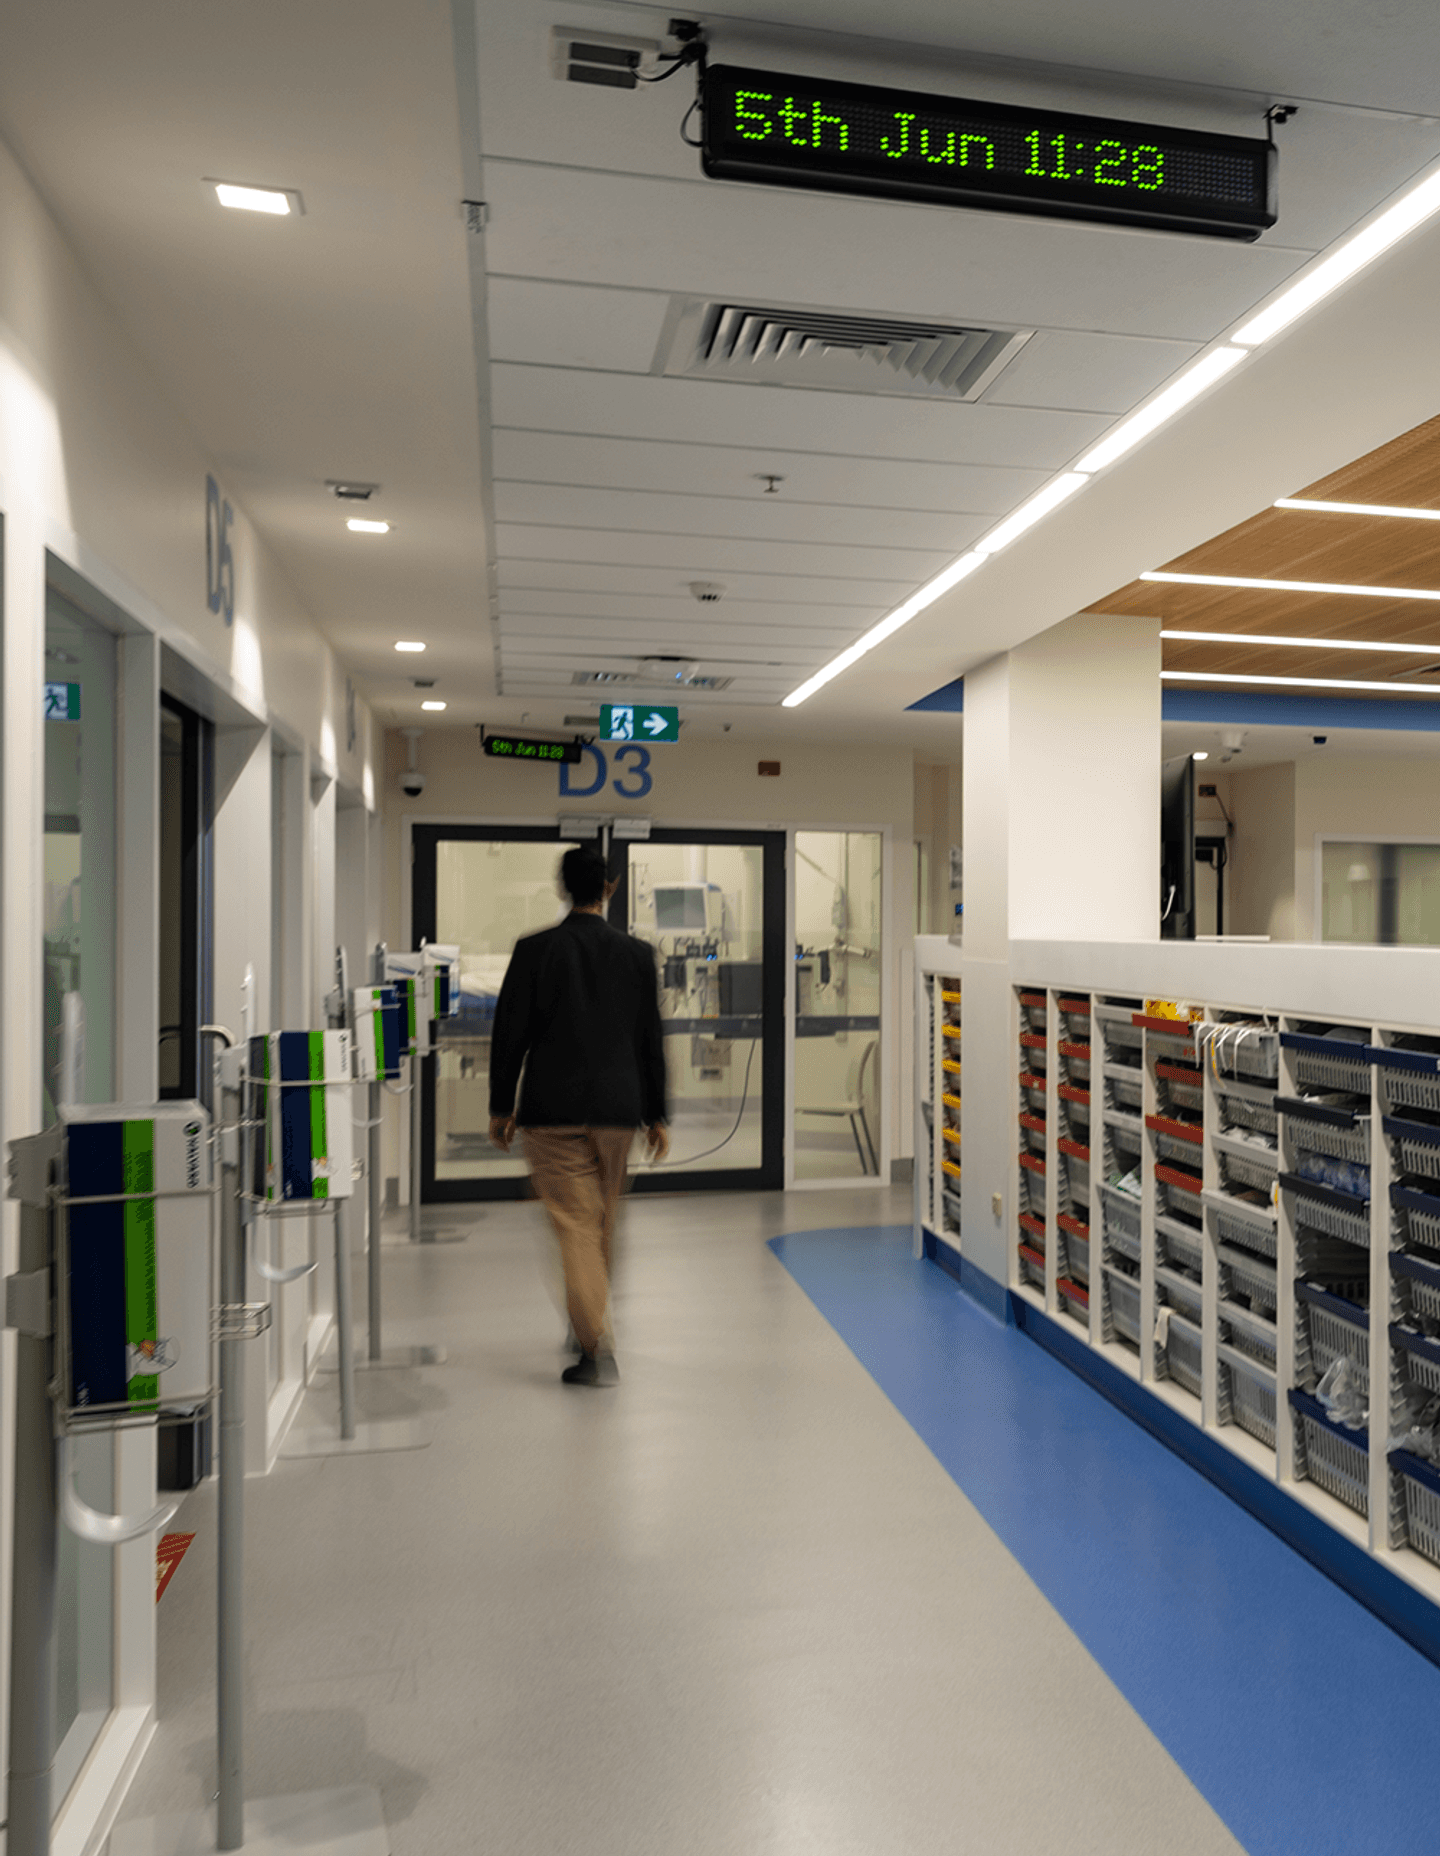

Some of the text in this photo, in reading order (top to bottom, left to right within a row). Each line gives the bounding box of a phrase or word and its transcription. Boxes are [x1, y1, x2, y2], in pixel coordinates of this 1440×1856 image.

[735, 90, 1166, 192] 5th Jun 11:28
[206, 473, 234, 627] D5
[559, 742, 653, 799] D3
